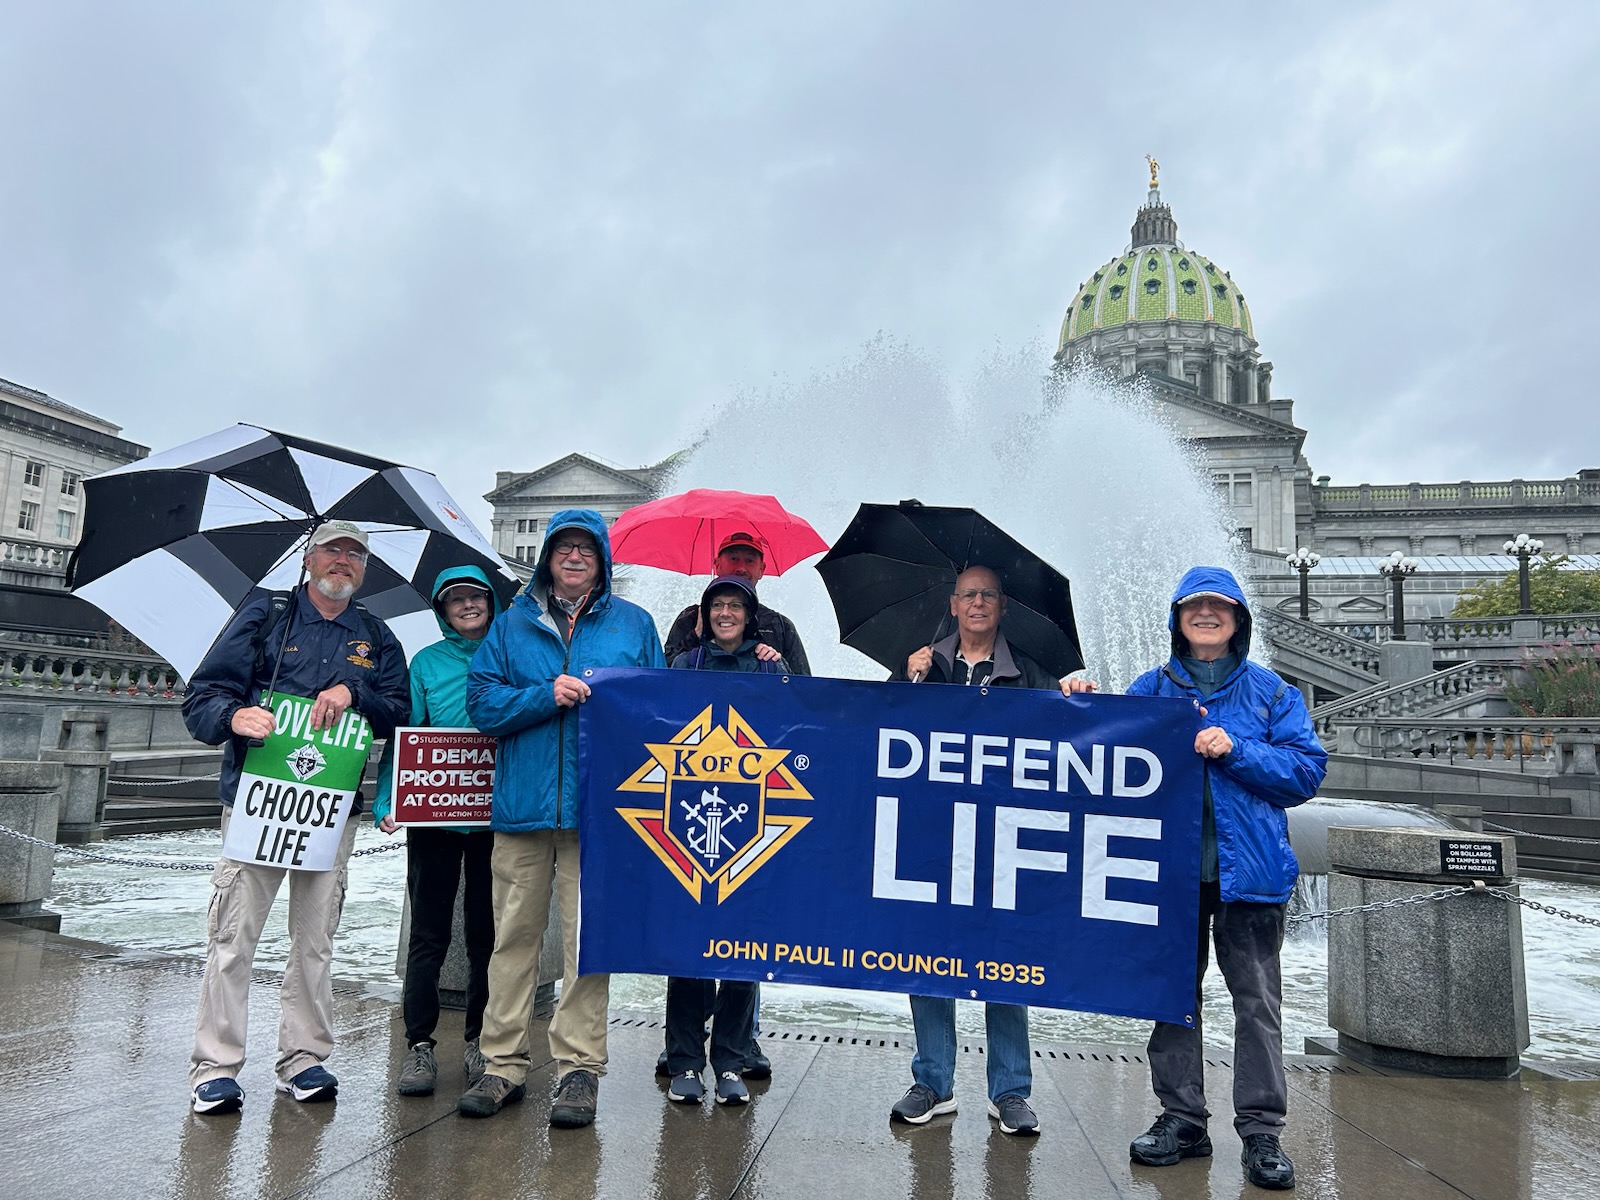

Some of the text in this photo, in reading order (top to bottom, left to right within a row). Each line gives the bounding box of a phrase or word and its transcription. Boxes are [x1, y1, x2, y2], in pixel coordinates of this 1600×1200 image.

[262, 697, 315, 741] OVE
[416, 748, 498, 764] I DEMA
[672, 749, 698, 777] K
[701, 755, 732, 773] OF
[738, 752, 762, 779] C
[877, 728, 1163, 798] DEFEND
[245, 780, 344, 828] CHOOSE
[402, 793, 427, 806] AT
[255, 825, 311, 866] LIFE
[873, 796, 1162, 926] LIFE
[702, 939, 1045, 986] JOHN PAUL II COUNCIL 13935
